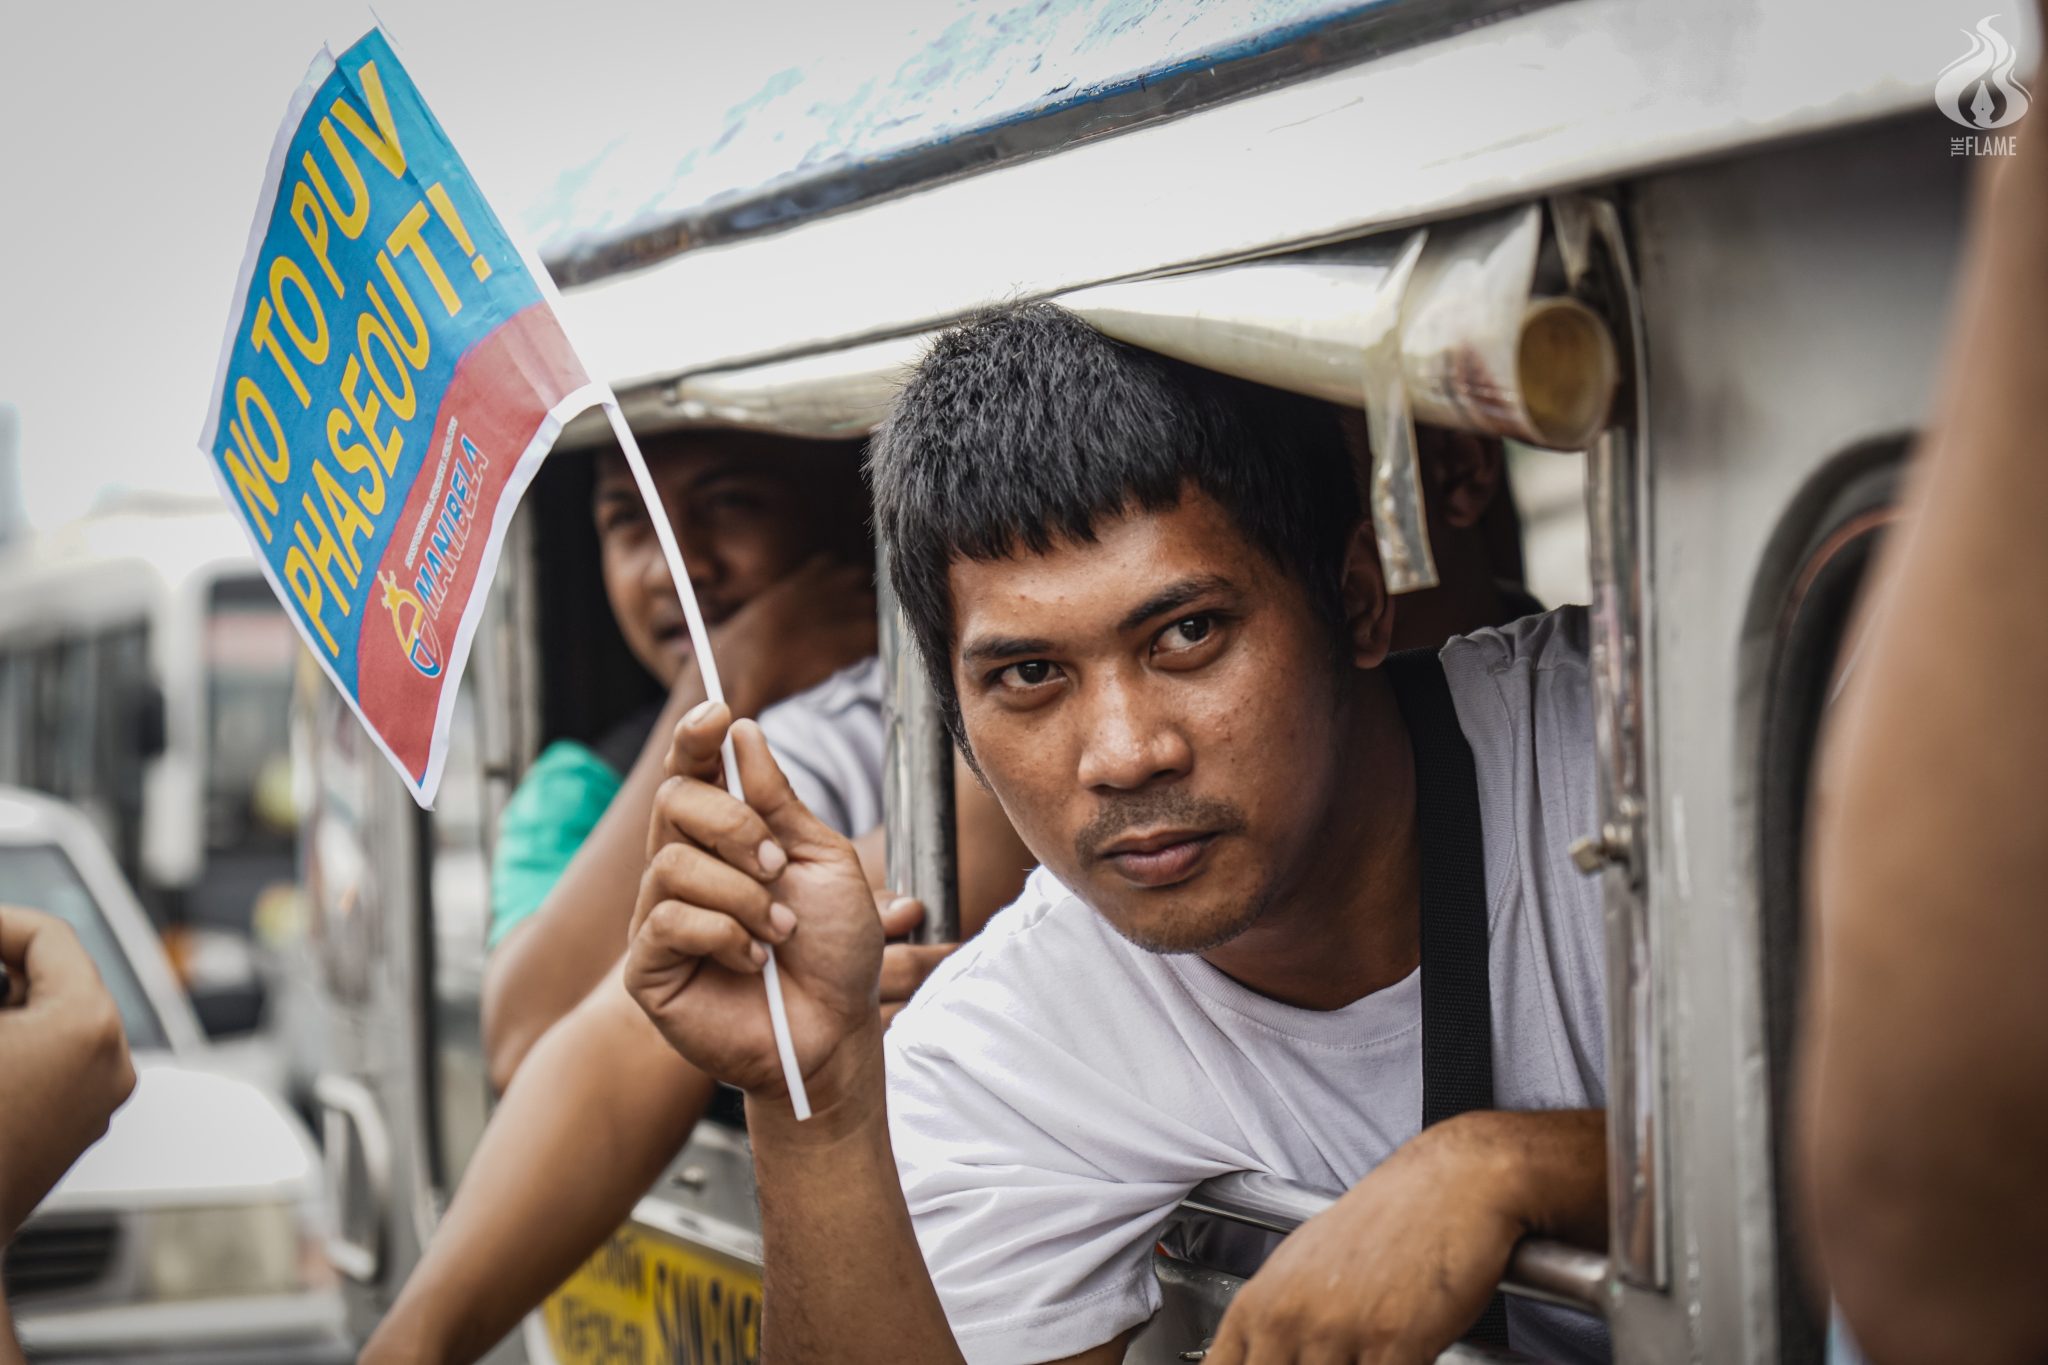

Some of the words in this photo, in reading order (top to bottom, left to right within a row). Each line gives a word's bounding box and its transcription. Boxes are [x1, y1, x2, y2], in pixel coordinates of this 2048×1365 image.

[289, 59, 408, 300] PUV
[251, 255, 330, 410] TO
[283, 182, 493, 658] PHASEOUT!
[224, 376, 290, 544] NO
[414, 433, 490, 621] MANIBELA
